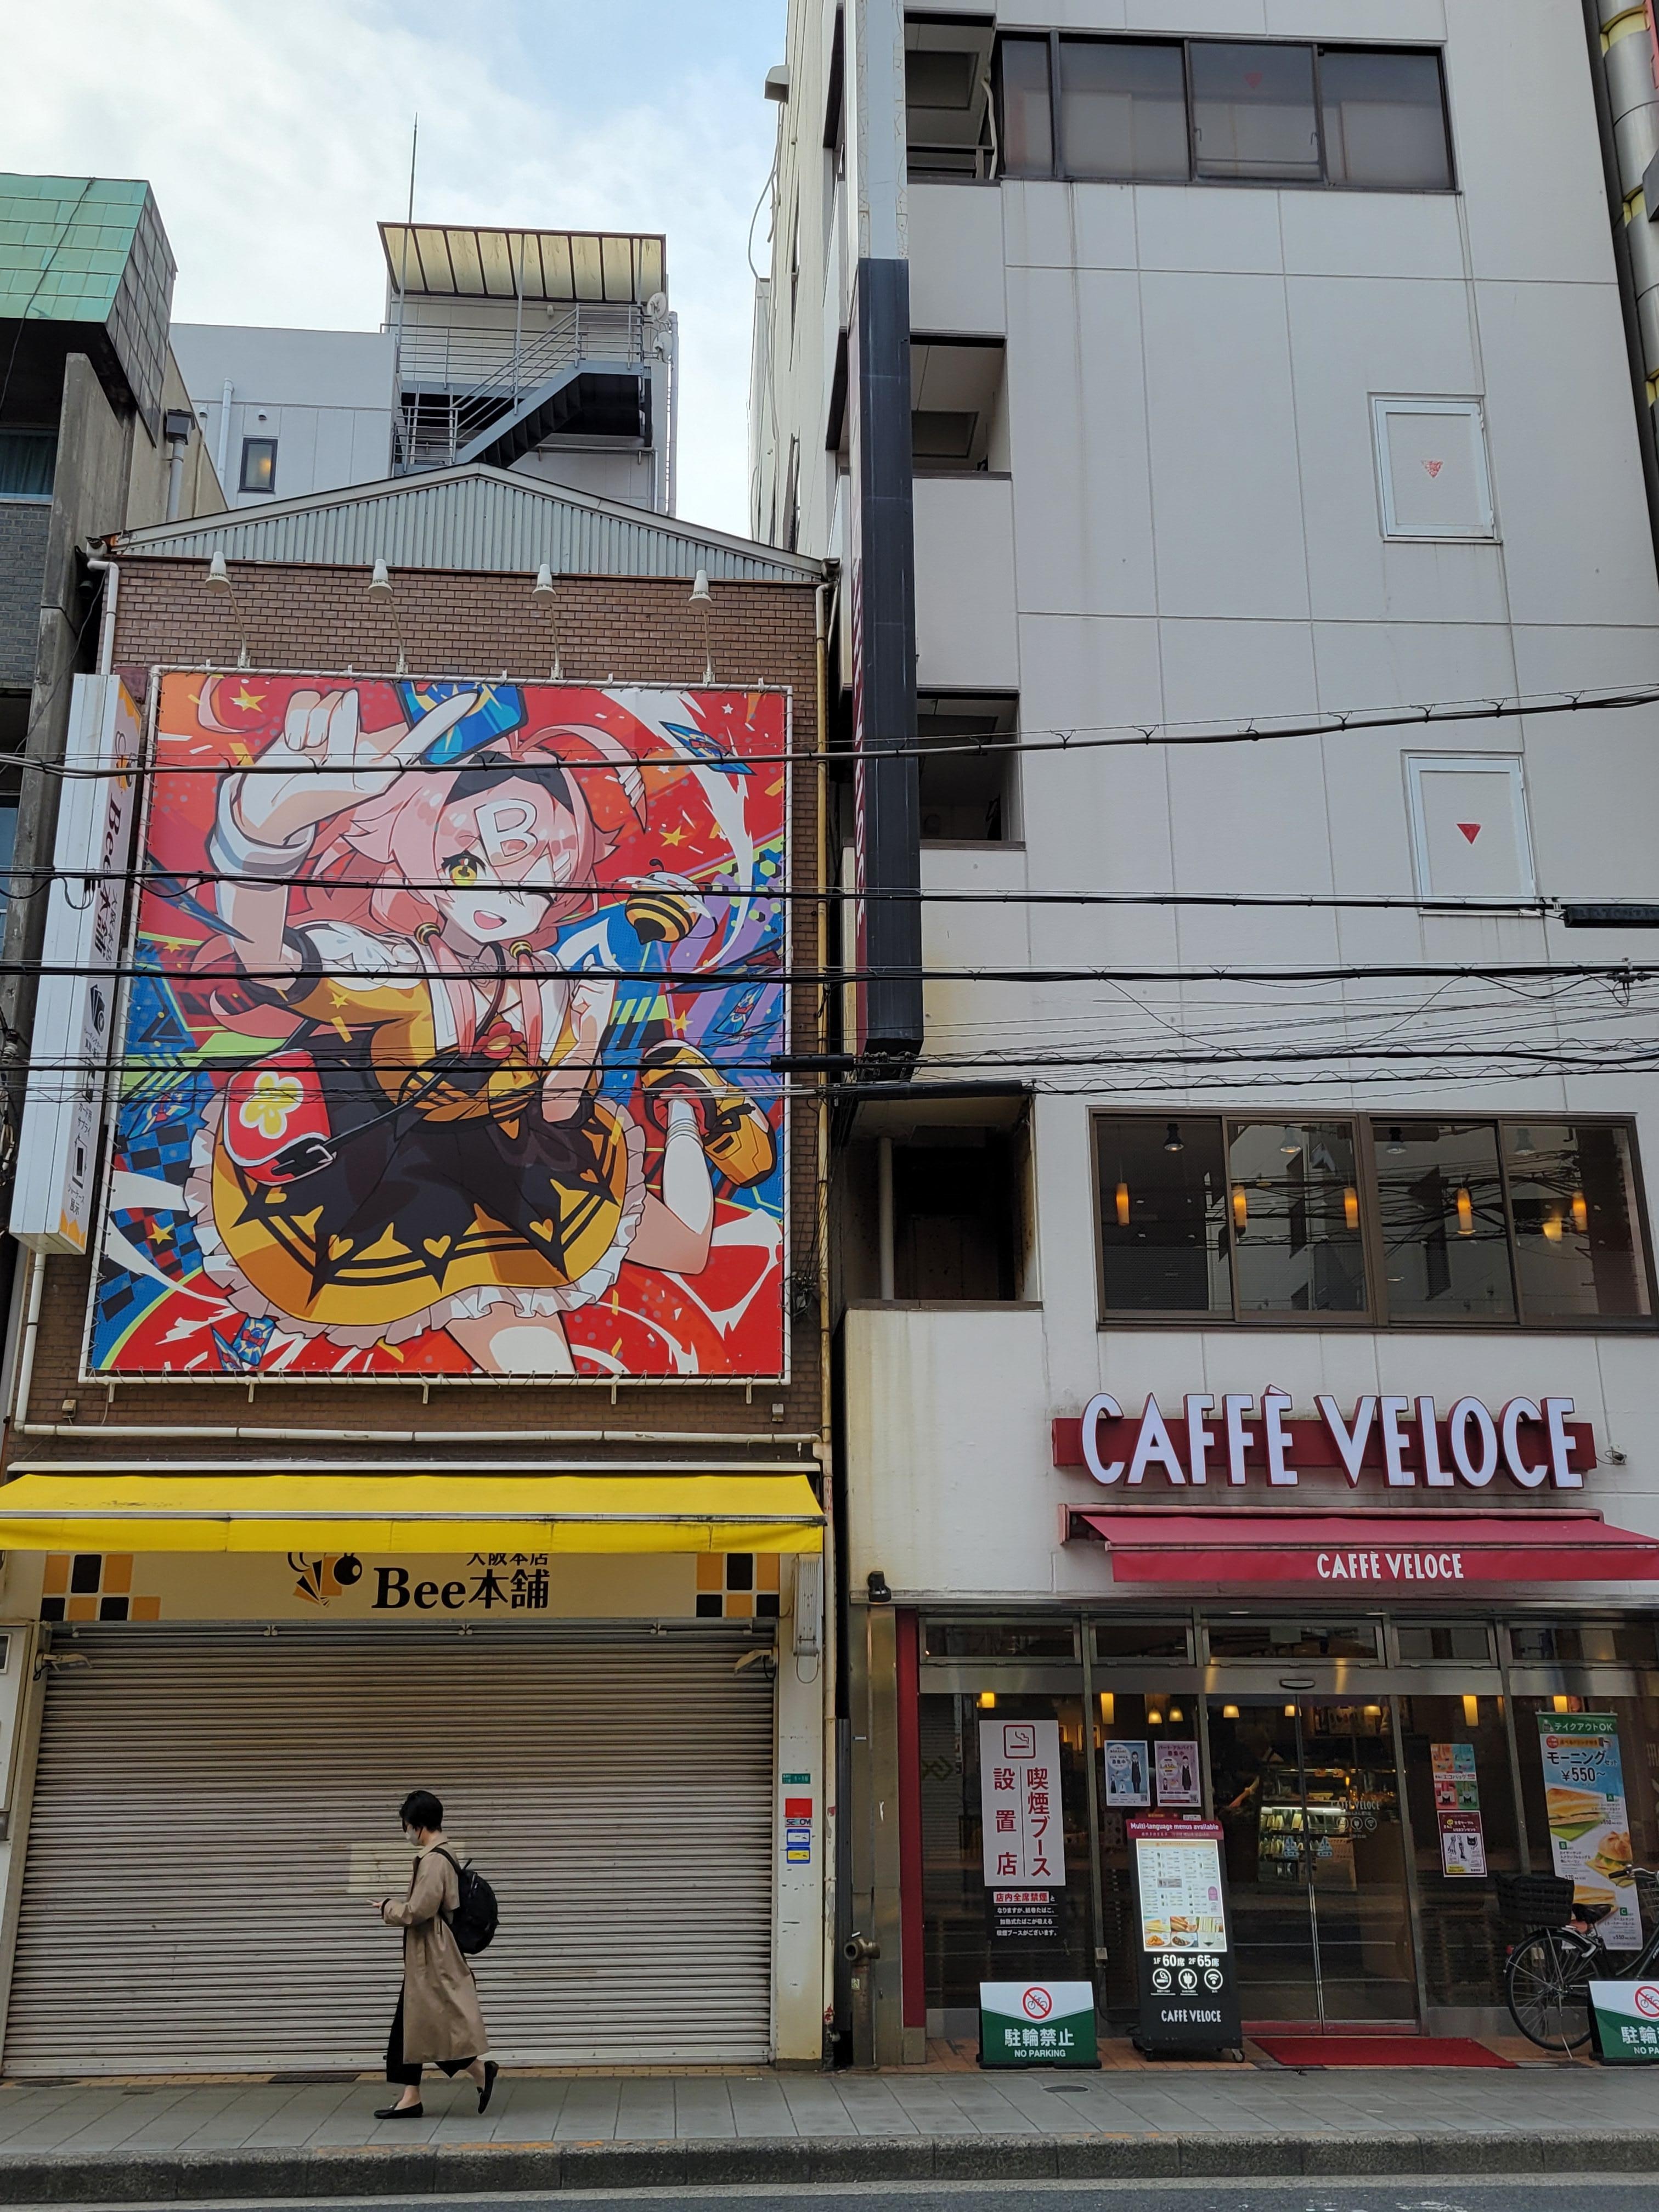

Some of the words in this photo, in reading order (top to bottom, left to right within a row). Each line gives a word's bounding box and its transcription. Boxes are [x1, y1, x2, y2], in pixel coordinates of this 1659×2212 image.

[1080, 1384, 1299, 1487] CAFFÈ
[1313, 1396, 1585, 1489] VELOCE
[1317, 1551, 1381, 1579] CAFFÈ
[1385, 1553, 1464, 1579] VELOCE
[371, 1567, 550, 1609] Bee本舗
[1554, 1723, 1613, 1732] テイクアウトOK
[993, 1768, 1018, 1876] 設置店
[1026, 1767, 1051, 1877] 喫煙ブース
[1130, 1822, 1172, 1831] Multi-language
[1189, 2010, 1222, 2023] VELOCE
[1005, 2028, 1075, 2047] 駐輪禁止
[1620, 2025, 1659, 2044] 駐輪
[1014, 2049, 1027, 2057] NO
[1029, 2049, 1066, 2057] PARKING
[1633, 2046, 1647, 2055] NO
